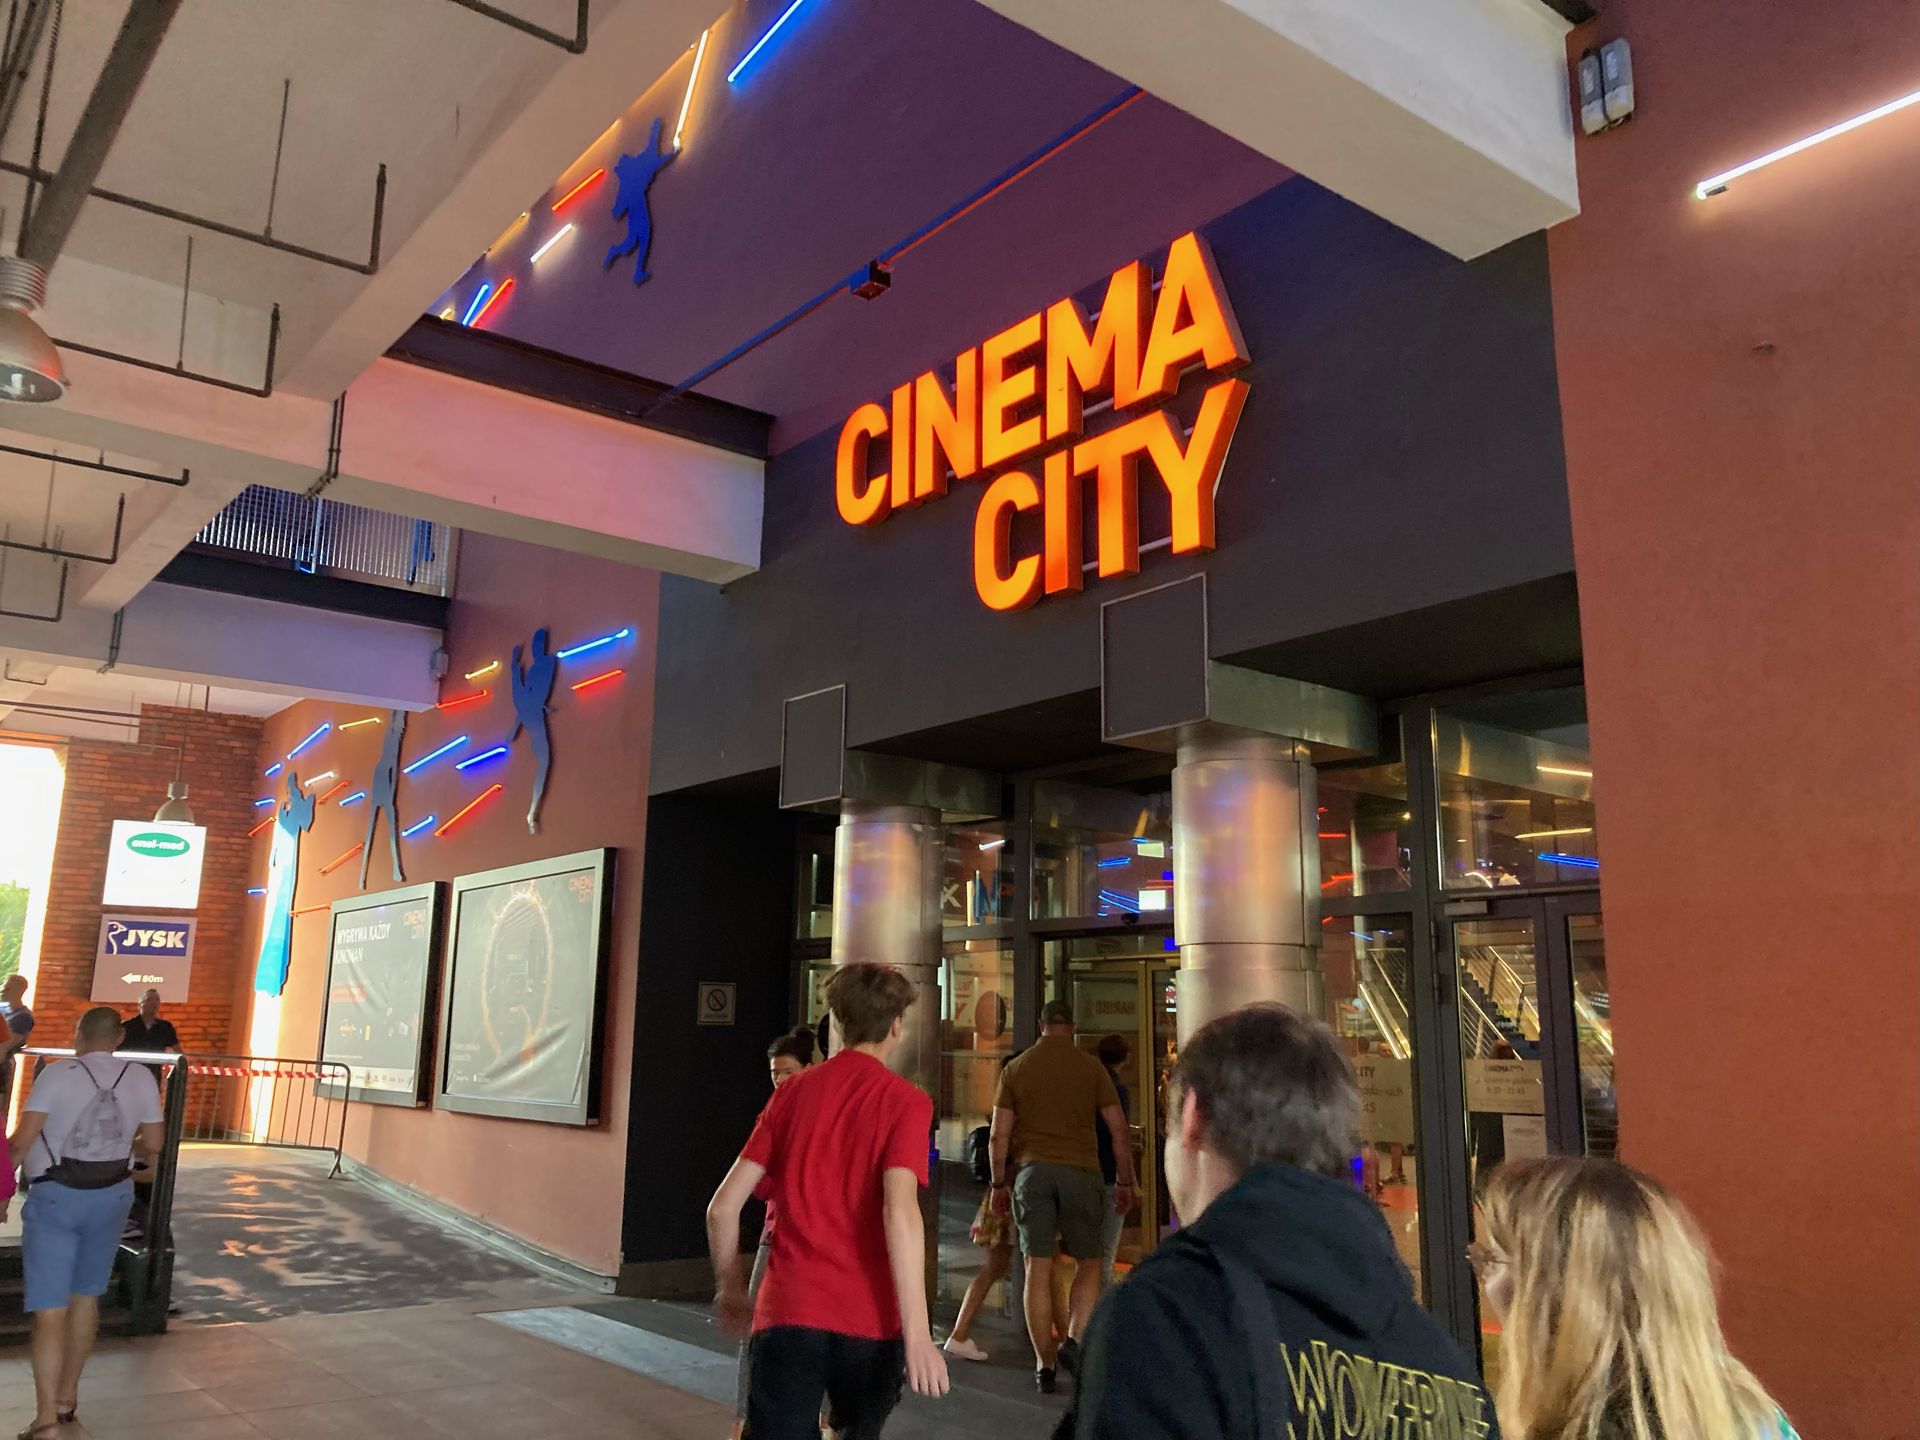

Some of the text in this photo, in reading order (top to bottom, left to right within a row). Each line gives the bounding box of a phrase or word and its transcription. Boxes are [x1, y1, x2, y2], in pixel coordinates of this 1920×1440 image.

[835, 231, 1244, 526] CINEMA
[974, 378, 1246, 611] CITY
[122, 929, 186, 948] JYSK
[337, 926, 368, 945] WYGRYWA
[368, 919, 392, 941] KAŻDY
